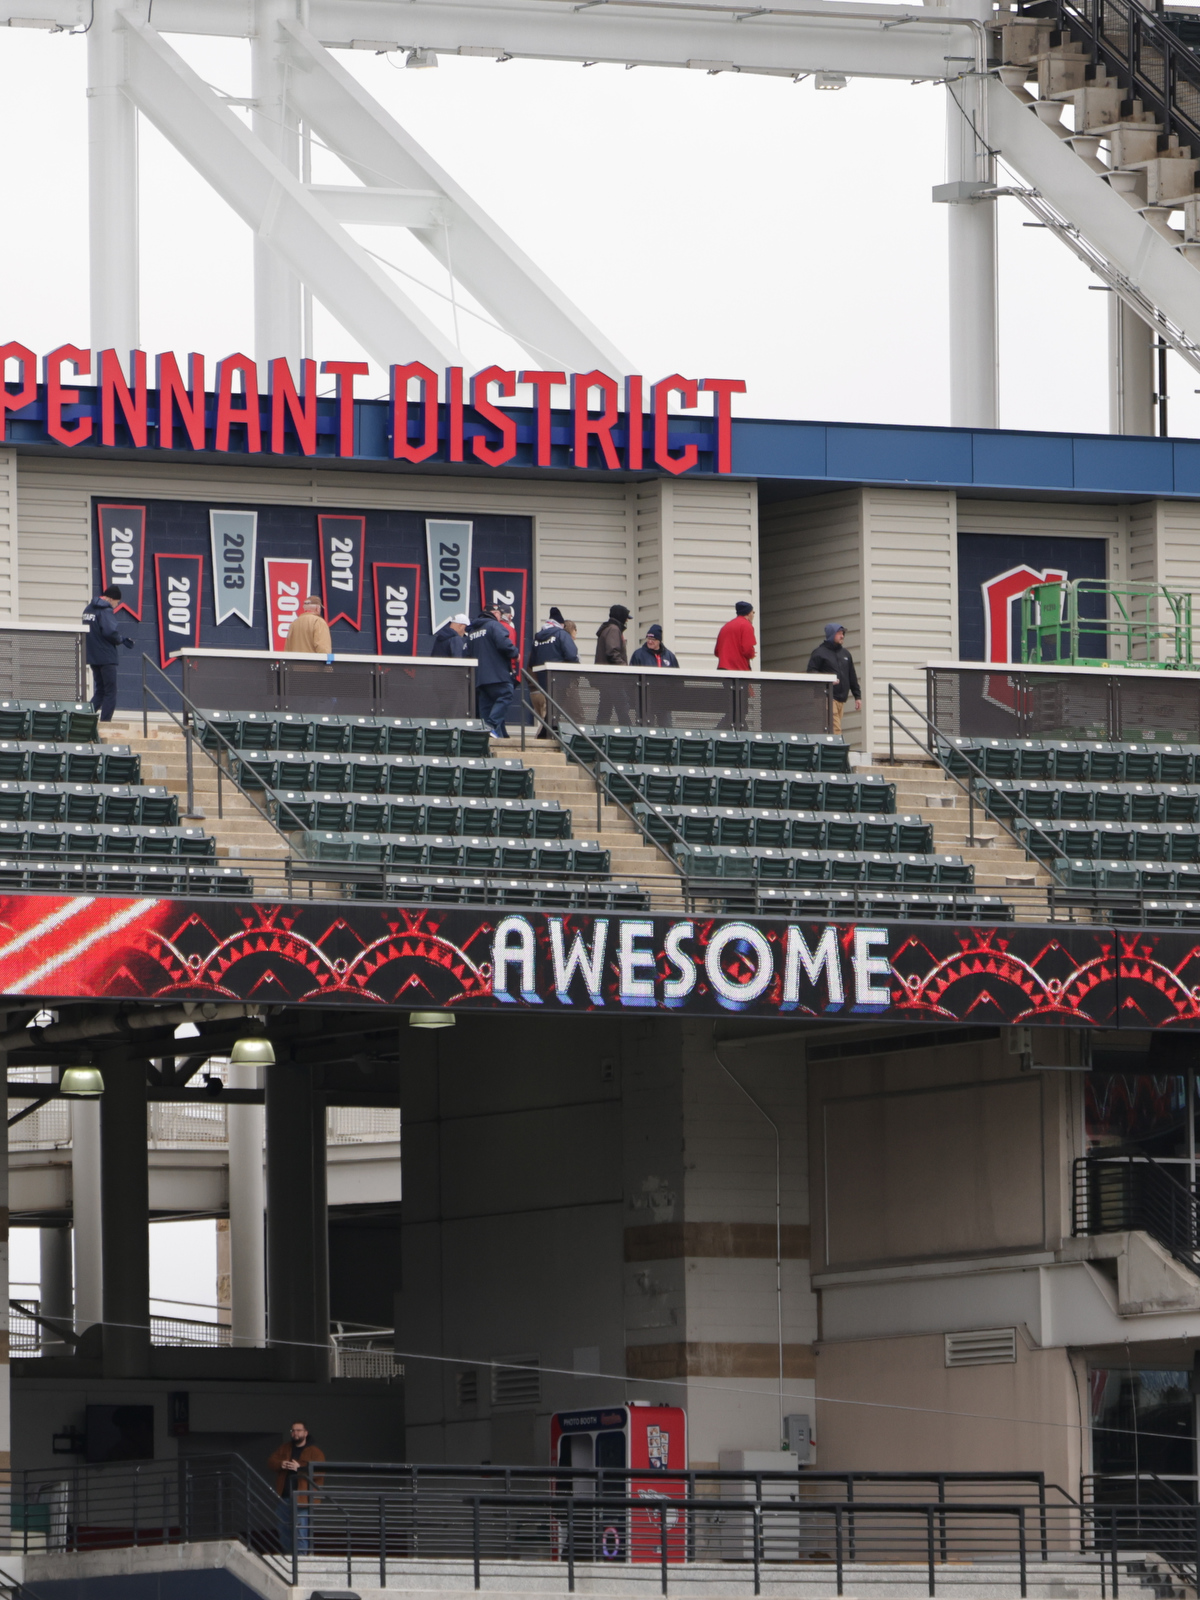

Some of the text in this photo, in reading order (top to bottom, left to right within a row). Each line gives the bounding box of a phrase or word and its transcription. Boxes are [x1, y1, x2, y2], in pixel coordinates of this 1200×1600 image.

[392, 361, 746, 475] DISTRICT
[111, 527, 134, 585] 2001
[223, 532, 245, 590] 2013
[331, 537, 353, 592] 2017
[439, 542, 461, 602] 2020
[168, 576, 190, 635] 2007
[386, 585, 408, 643] 2018
[469, 629, 487, 640] STAFF
[492, 912, 892, 1008] AWESOME
[563, 1417, 580, 1426] PHOTO
[580, 1416, 598, 1425] BOOTH
